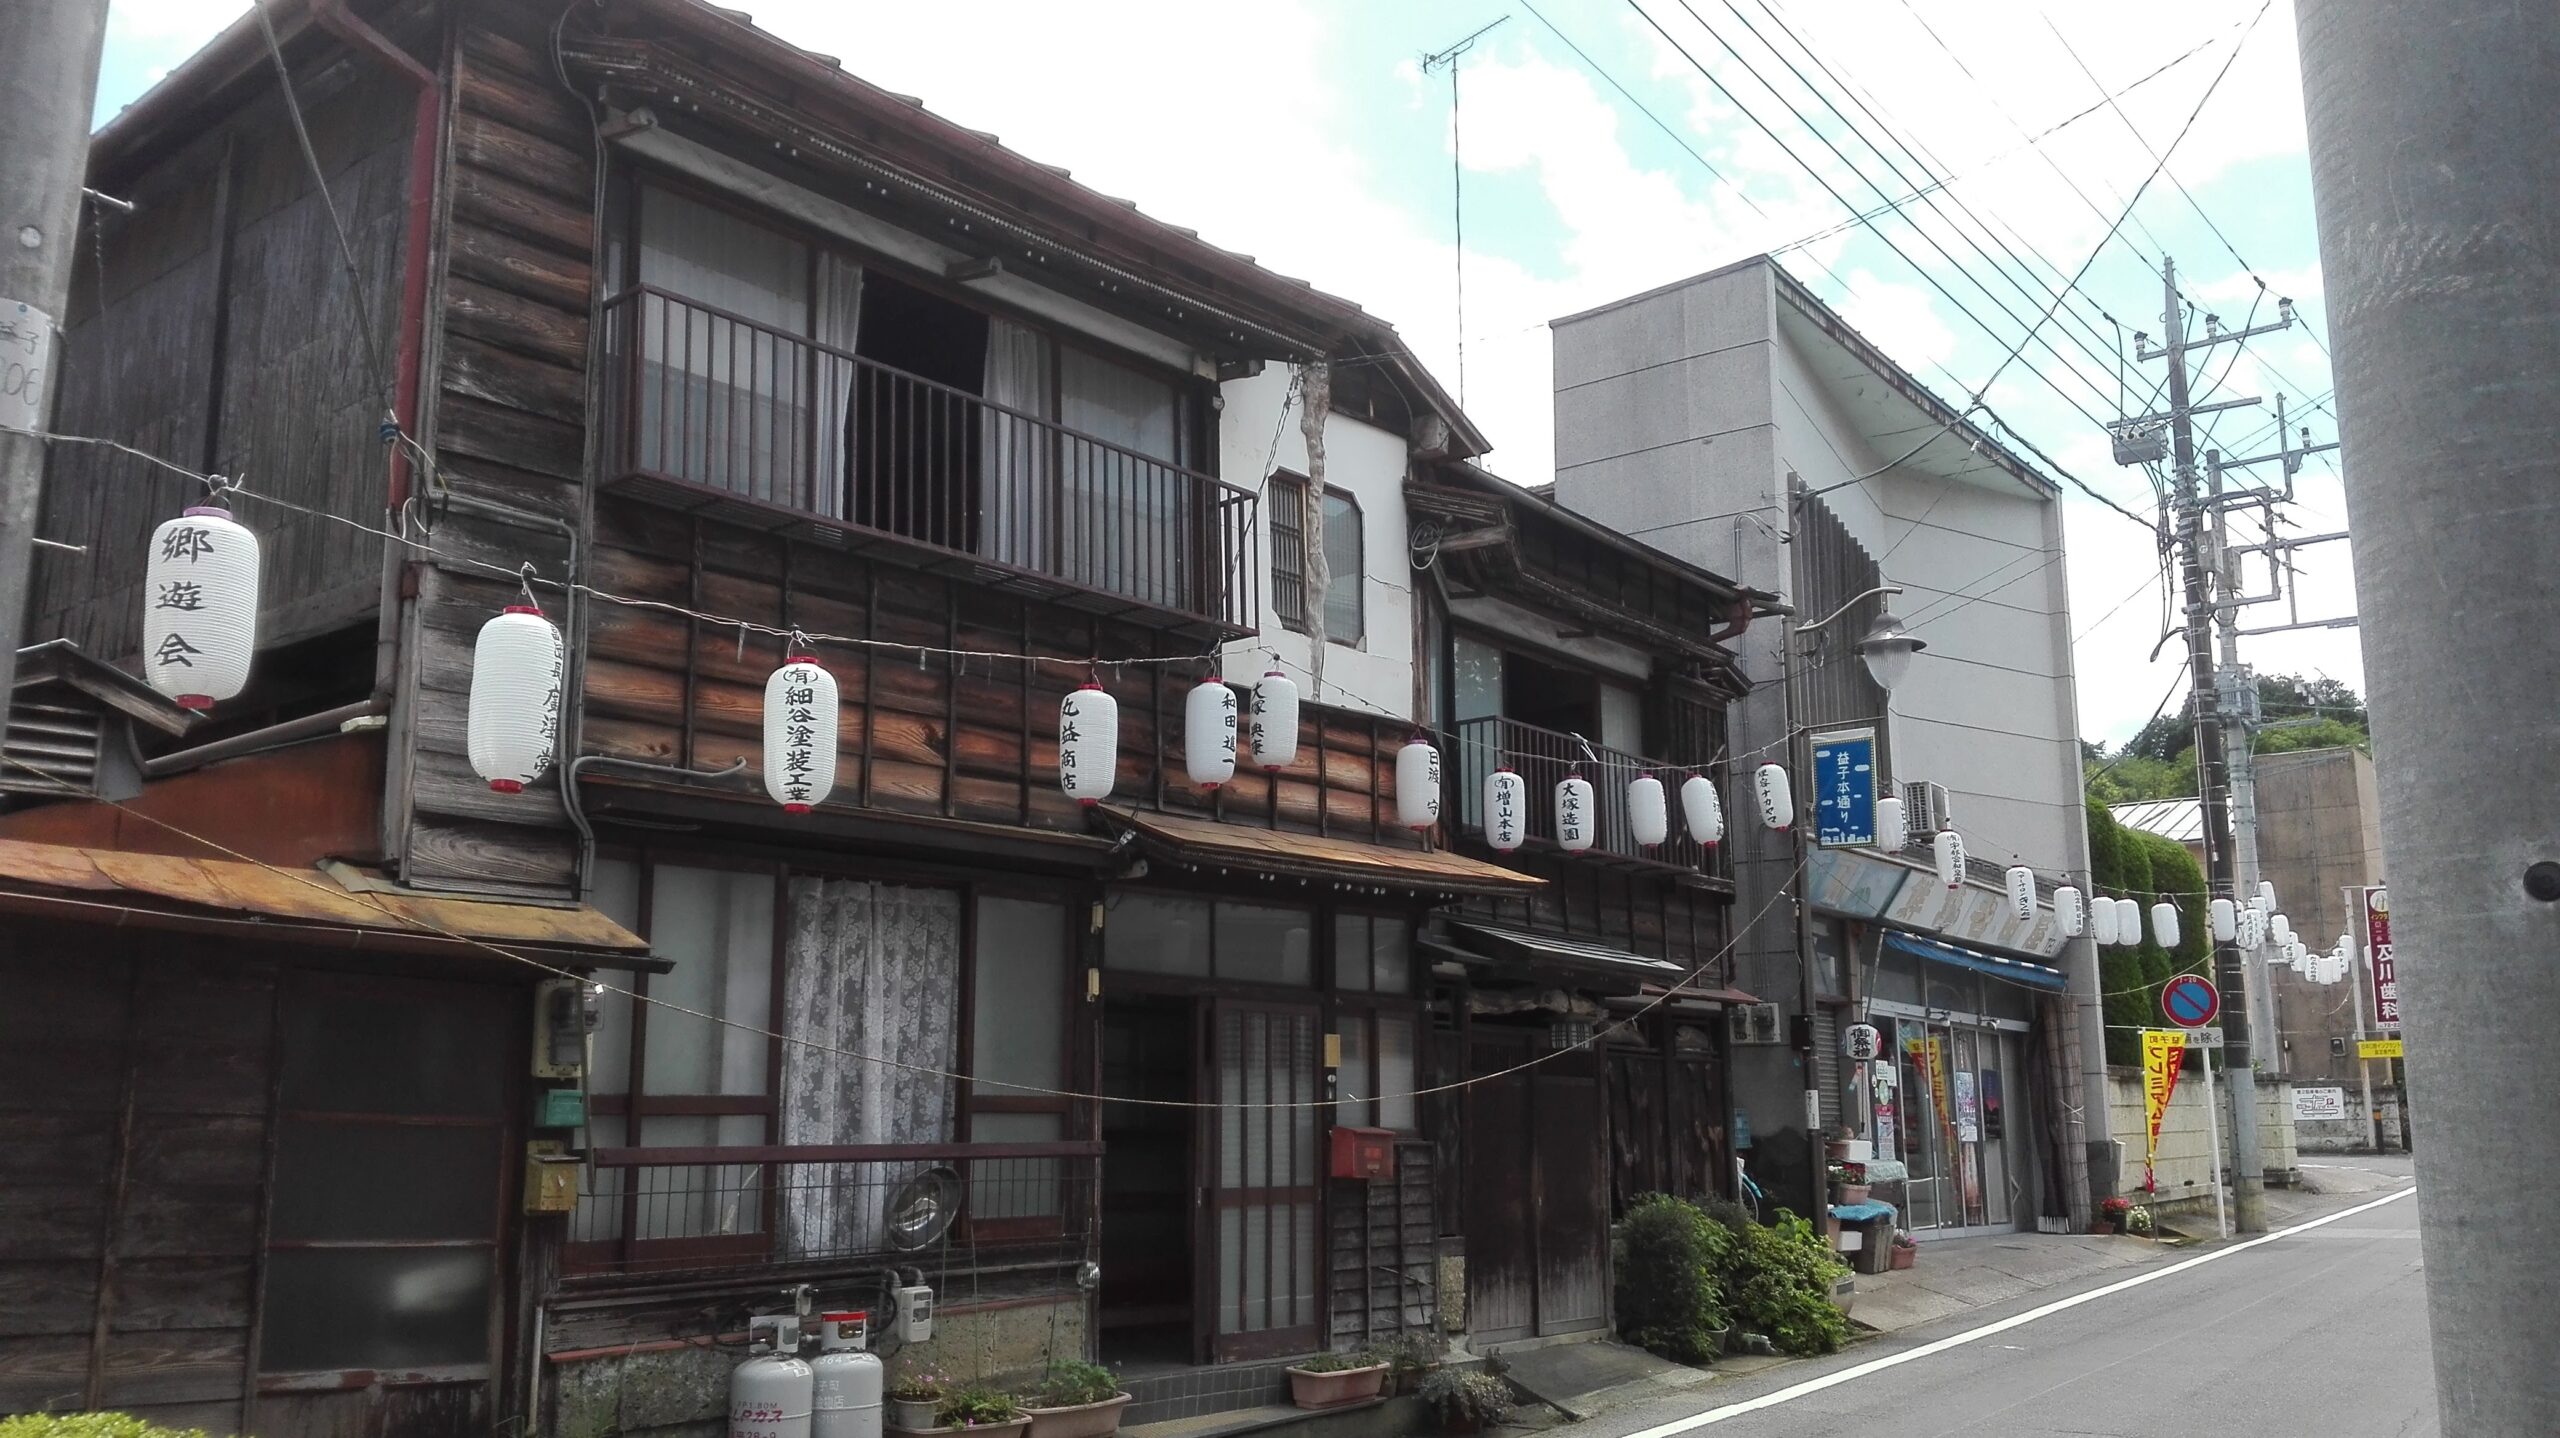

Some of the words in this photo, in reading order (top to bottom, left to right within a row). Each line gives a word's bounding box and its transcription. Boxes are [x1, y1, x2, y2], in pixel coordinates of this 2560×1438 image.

[155, 527, 214, 667] 郷遊会
[783, 668, 818, 801] (有)細谷塗装工業
[1061, 697, 1081, 790] 丸益商店
[1222, 693, 1236, 763] 和田進一
[1758, 769, 1777, 824] 理容ナカヤマ
[1837, 751, 1850, 823] 益子本通り
[2377, 944, 2399, 1019] 及川歯科
